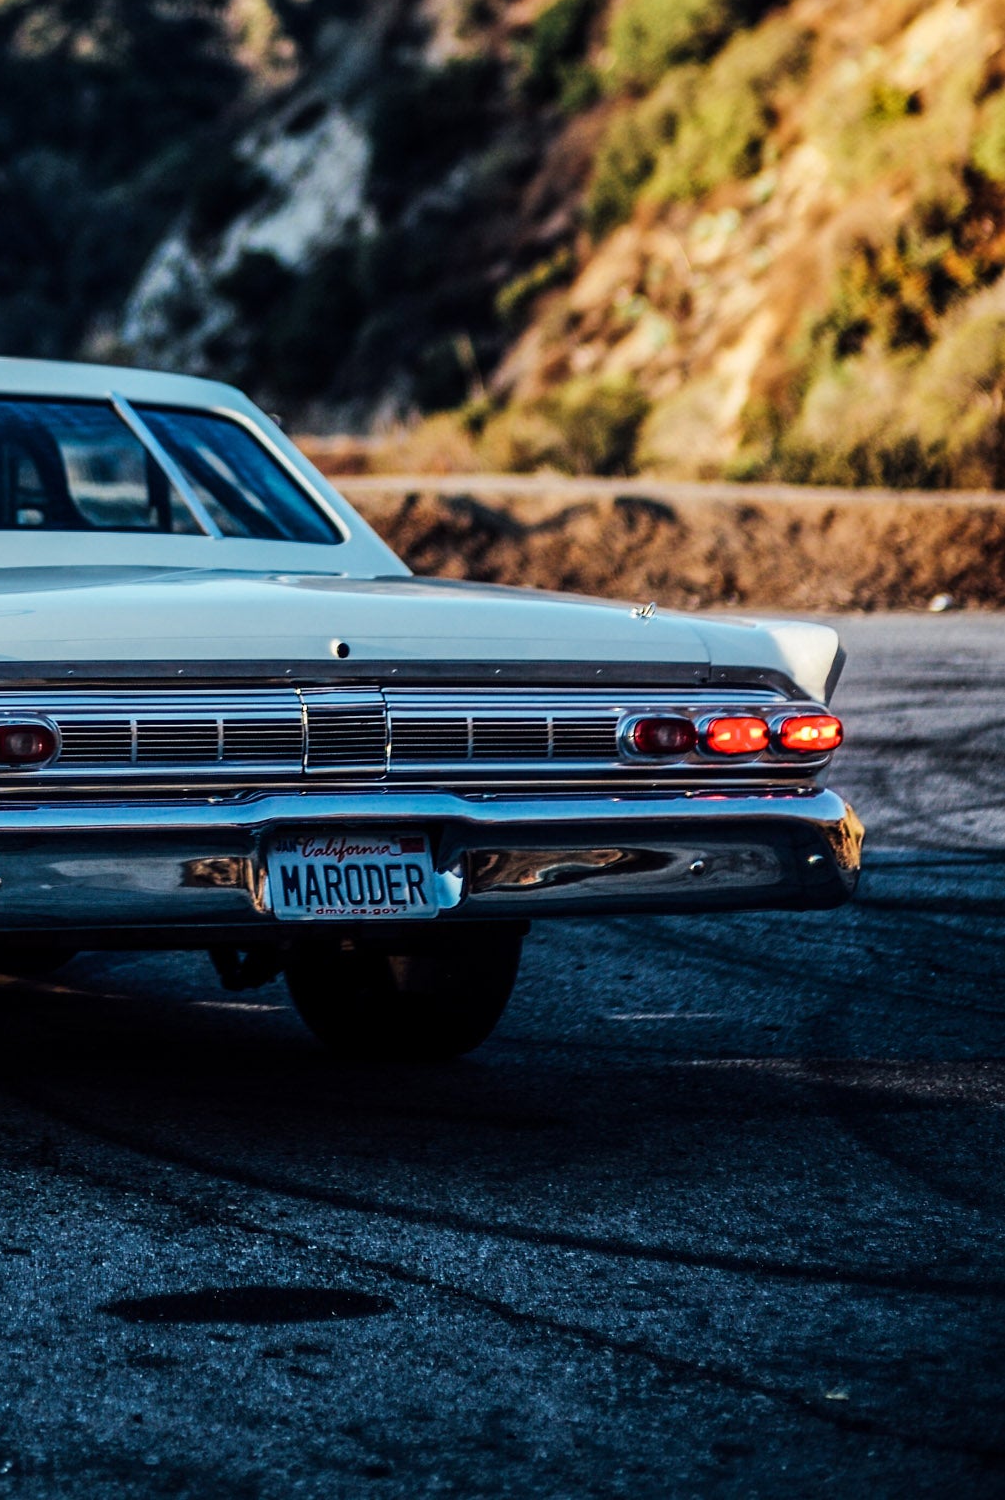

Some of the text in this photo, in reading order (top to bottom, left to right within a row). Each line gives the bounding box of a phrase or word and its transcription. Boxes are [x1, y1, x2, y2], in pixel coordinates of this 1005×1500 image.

[302, 836, 394, 863] California
[281, 863, 428, 907] MARODER
[315, 906, 399, 916] dmv.ca.gov
